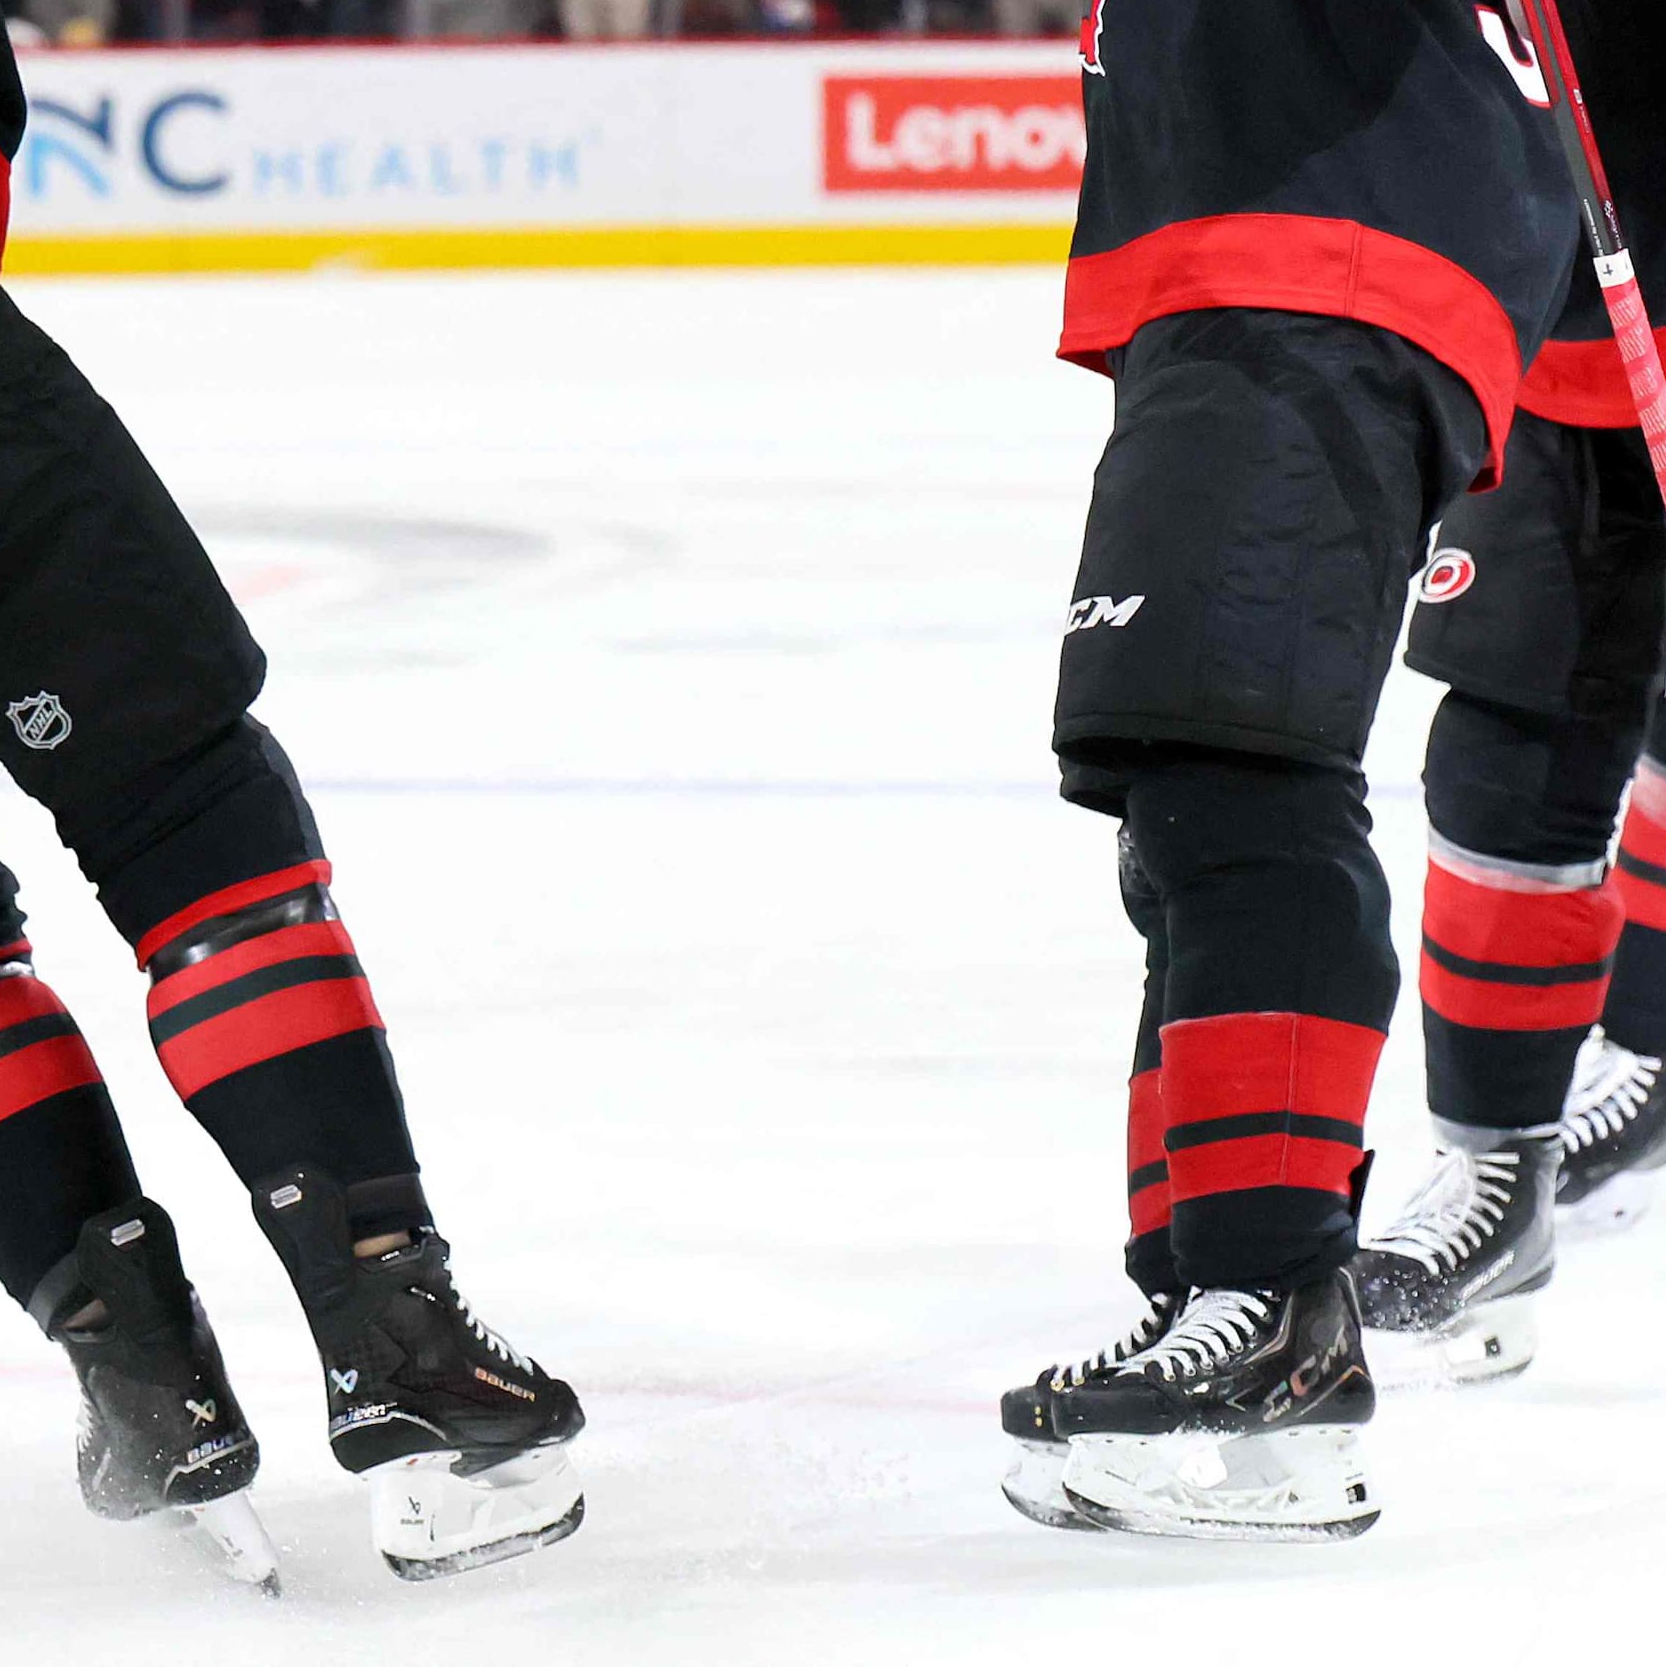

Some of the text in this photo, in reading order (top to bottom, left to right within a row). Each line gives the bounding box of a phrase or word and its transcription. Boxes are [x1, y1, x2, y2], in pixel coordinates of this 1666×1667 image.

[25, 89, 581, 201] NC HEALTH
[844, 89, 1087, 173] Lenov
[1064, 594, 1146, 636] CM
[28, 705, 54, 738] NHL
[475, 1366, 536, 1403] BAUER
